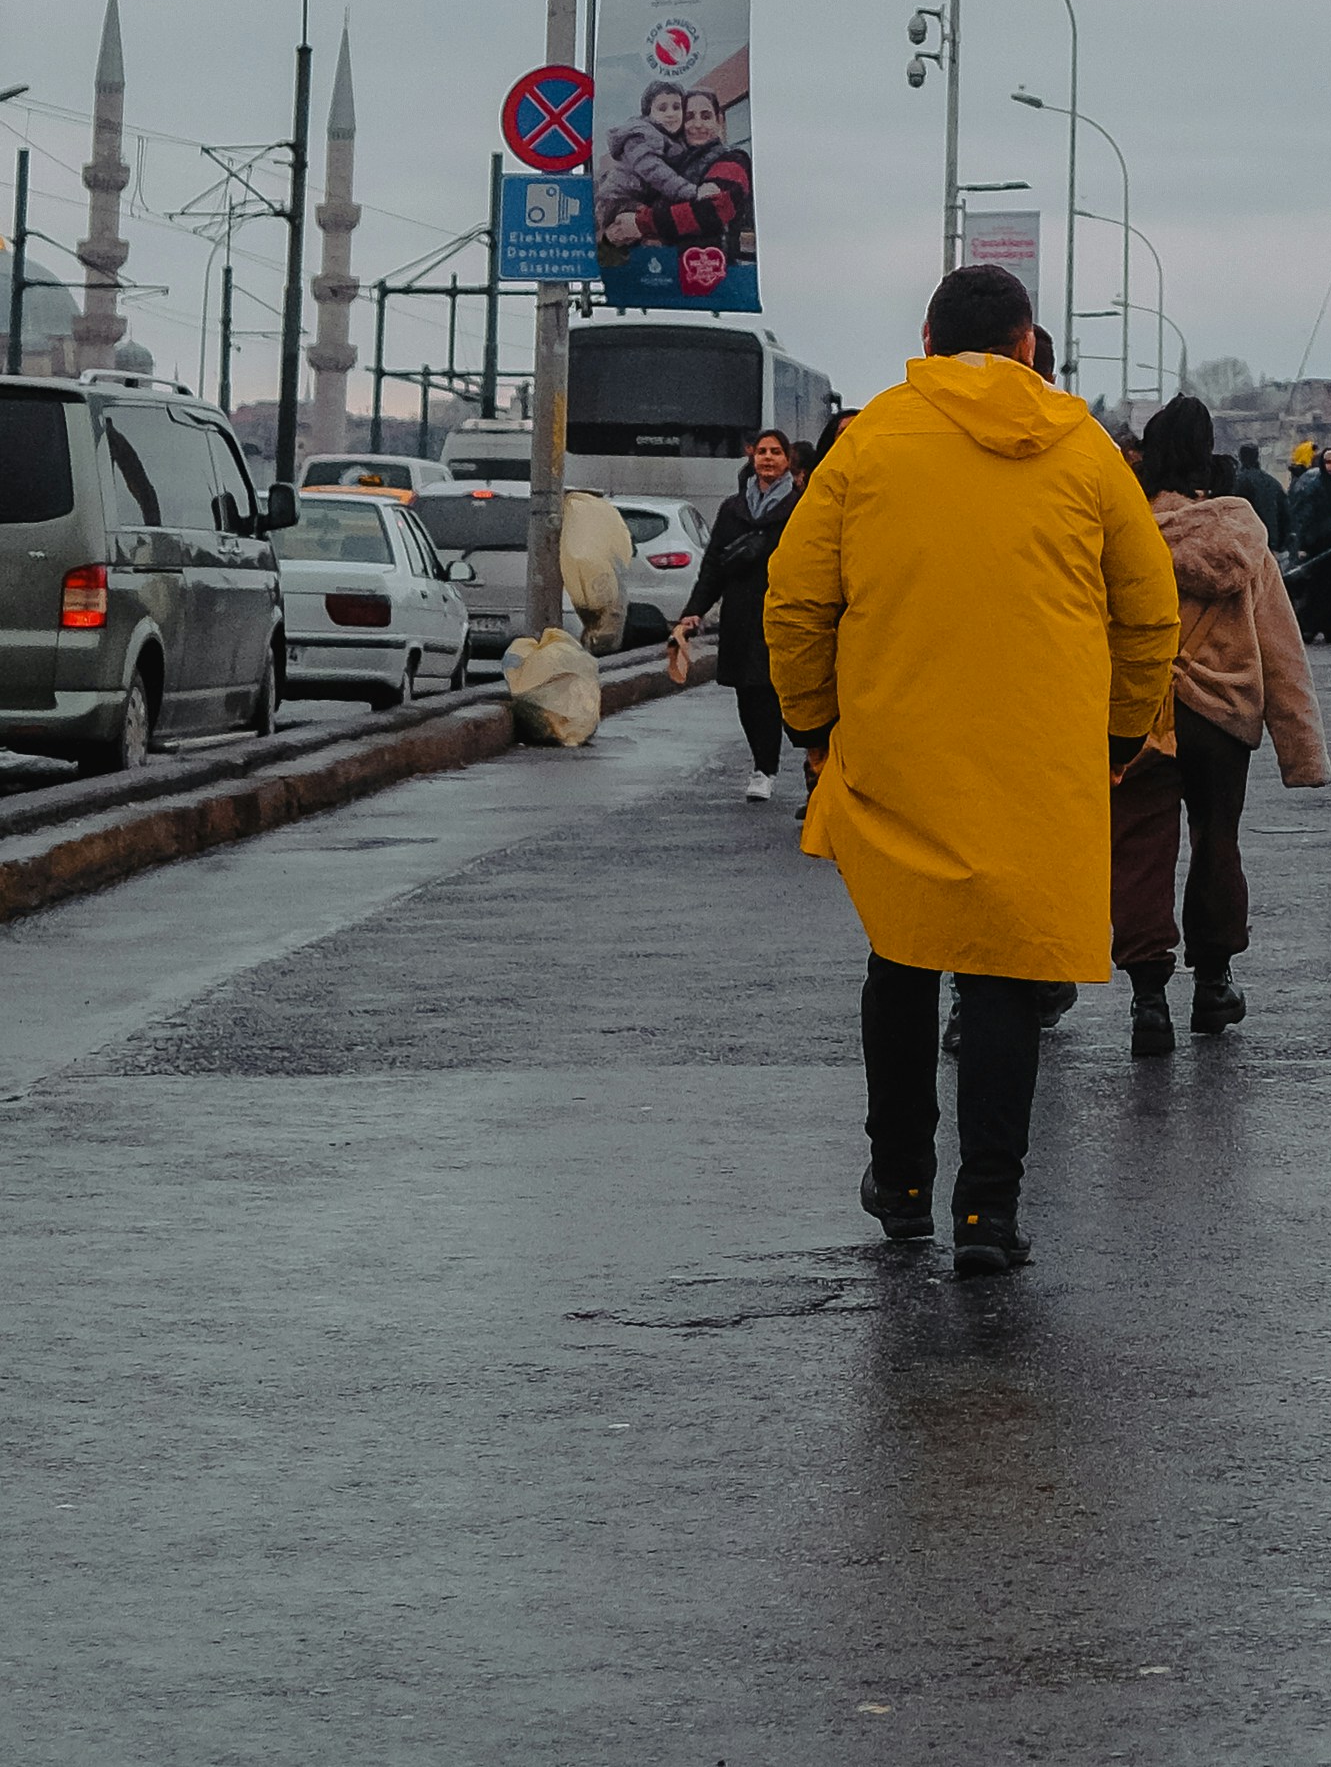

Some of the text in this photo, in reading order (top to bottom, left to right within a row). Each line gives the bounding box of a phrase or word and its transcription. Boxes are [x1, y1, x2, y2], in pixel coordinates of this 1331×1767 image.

[509, 232, 594, 244] Elektronik
[507, 246, 596, 259] Denetleme
[520, 261, 582, 273] Sistemi
